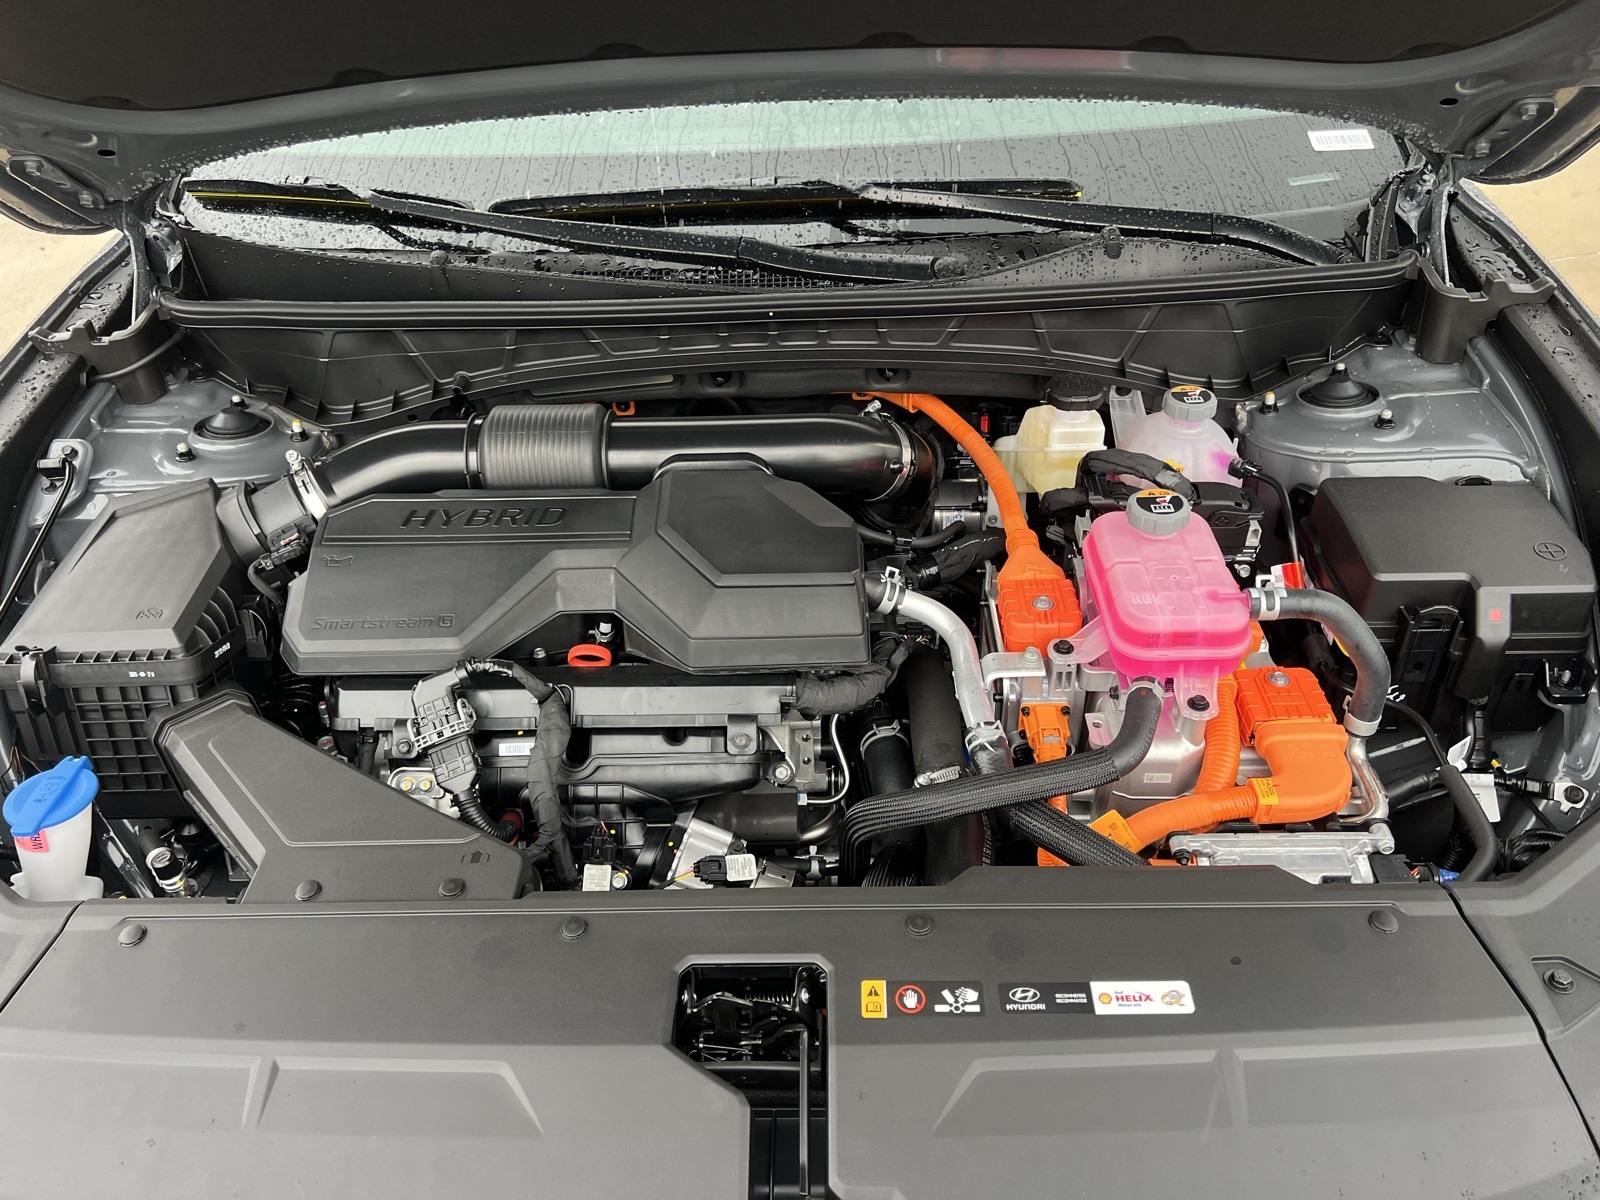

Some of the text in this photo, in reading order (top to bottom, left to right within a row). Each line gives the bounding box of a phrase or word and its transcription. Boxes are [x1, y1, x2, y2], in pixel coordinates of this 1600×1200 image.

[400, 507, 567, 529] HYBRID
[311, 613, 456, 630] Smartstream G
[31, 832, 43, 850] WR
[1006, 1003, 1046, 1011] HYUNDAI
[1115, 994, 1154, 1003] HELIX
